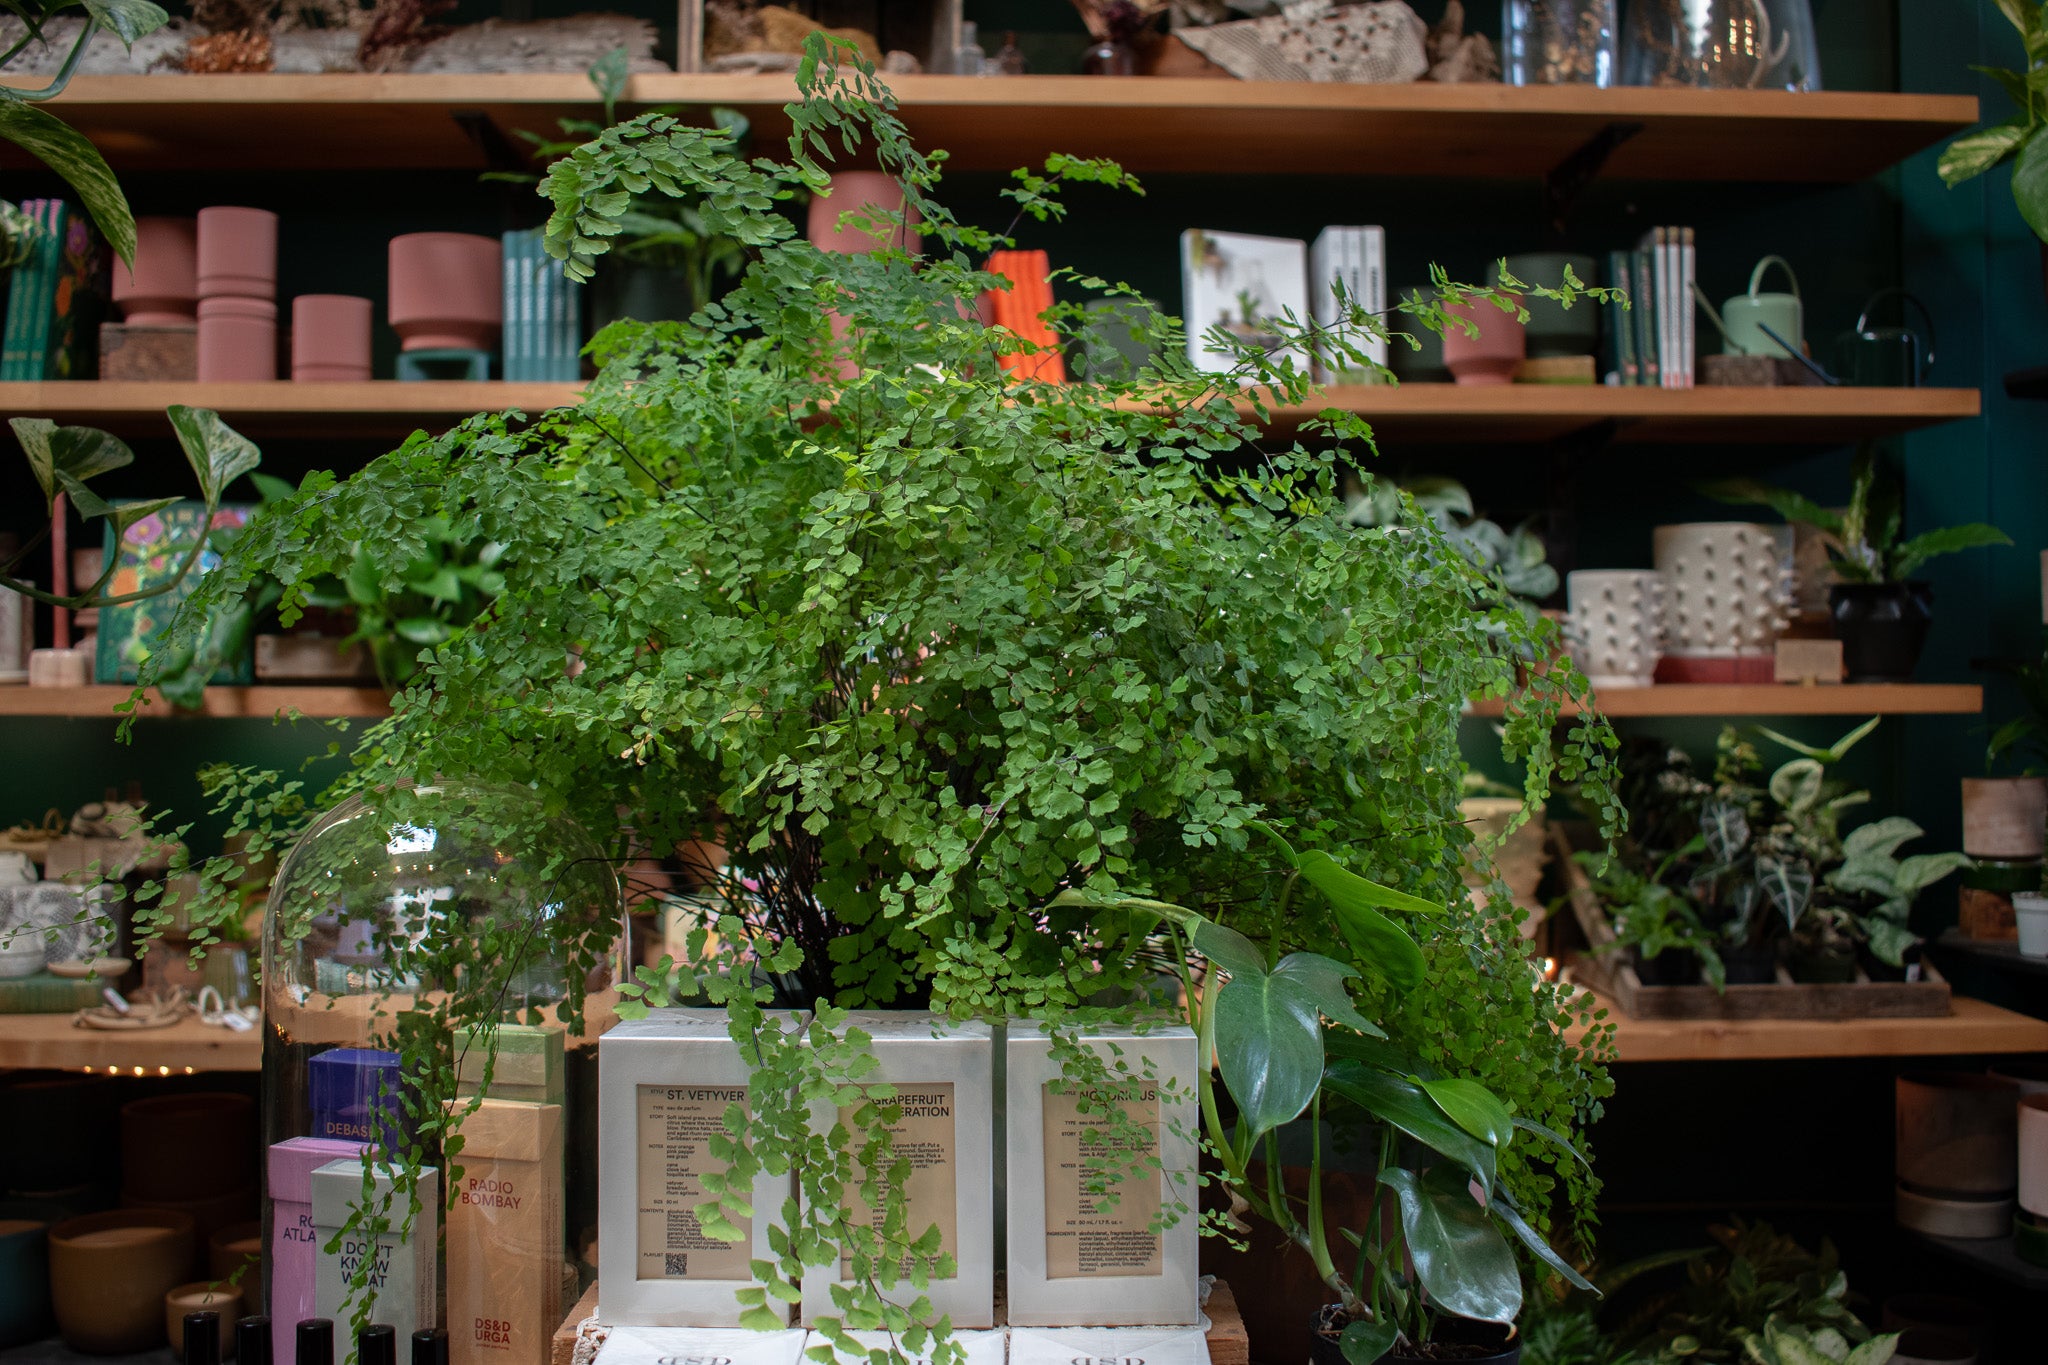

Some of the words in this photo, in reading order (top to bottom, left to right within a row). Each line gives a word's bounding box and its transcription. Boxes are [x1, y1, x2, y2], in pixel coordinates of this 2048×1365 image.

[667, 1090, 684, 1100] ST.
[689, 1090, 744, 1100] VETYVER
[873, 1095, 945, 1104] GRAPEFRUIT
[1080, 1090, 1155, 1100] NORIUS
[875, 1107, 949, 1116] ERATION
[326, 1122, 384, 1139] DEBAS
[470, 1178, 513, 1194] RADIO
[462, 1192, 521, 1209] BOMBAY
[283, 1228, 316, 1242] ATLA
[346, 1242, 393, 1258] DO'T
[341, 1256, 389, 1272] KNW
[342, 1271, 387, 1287] WAT
[475, 1318, 510, 1331] DS&D
[475, 1330, 510, 1344] URGA
